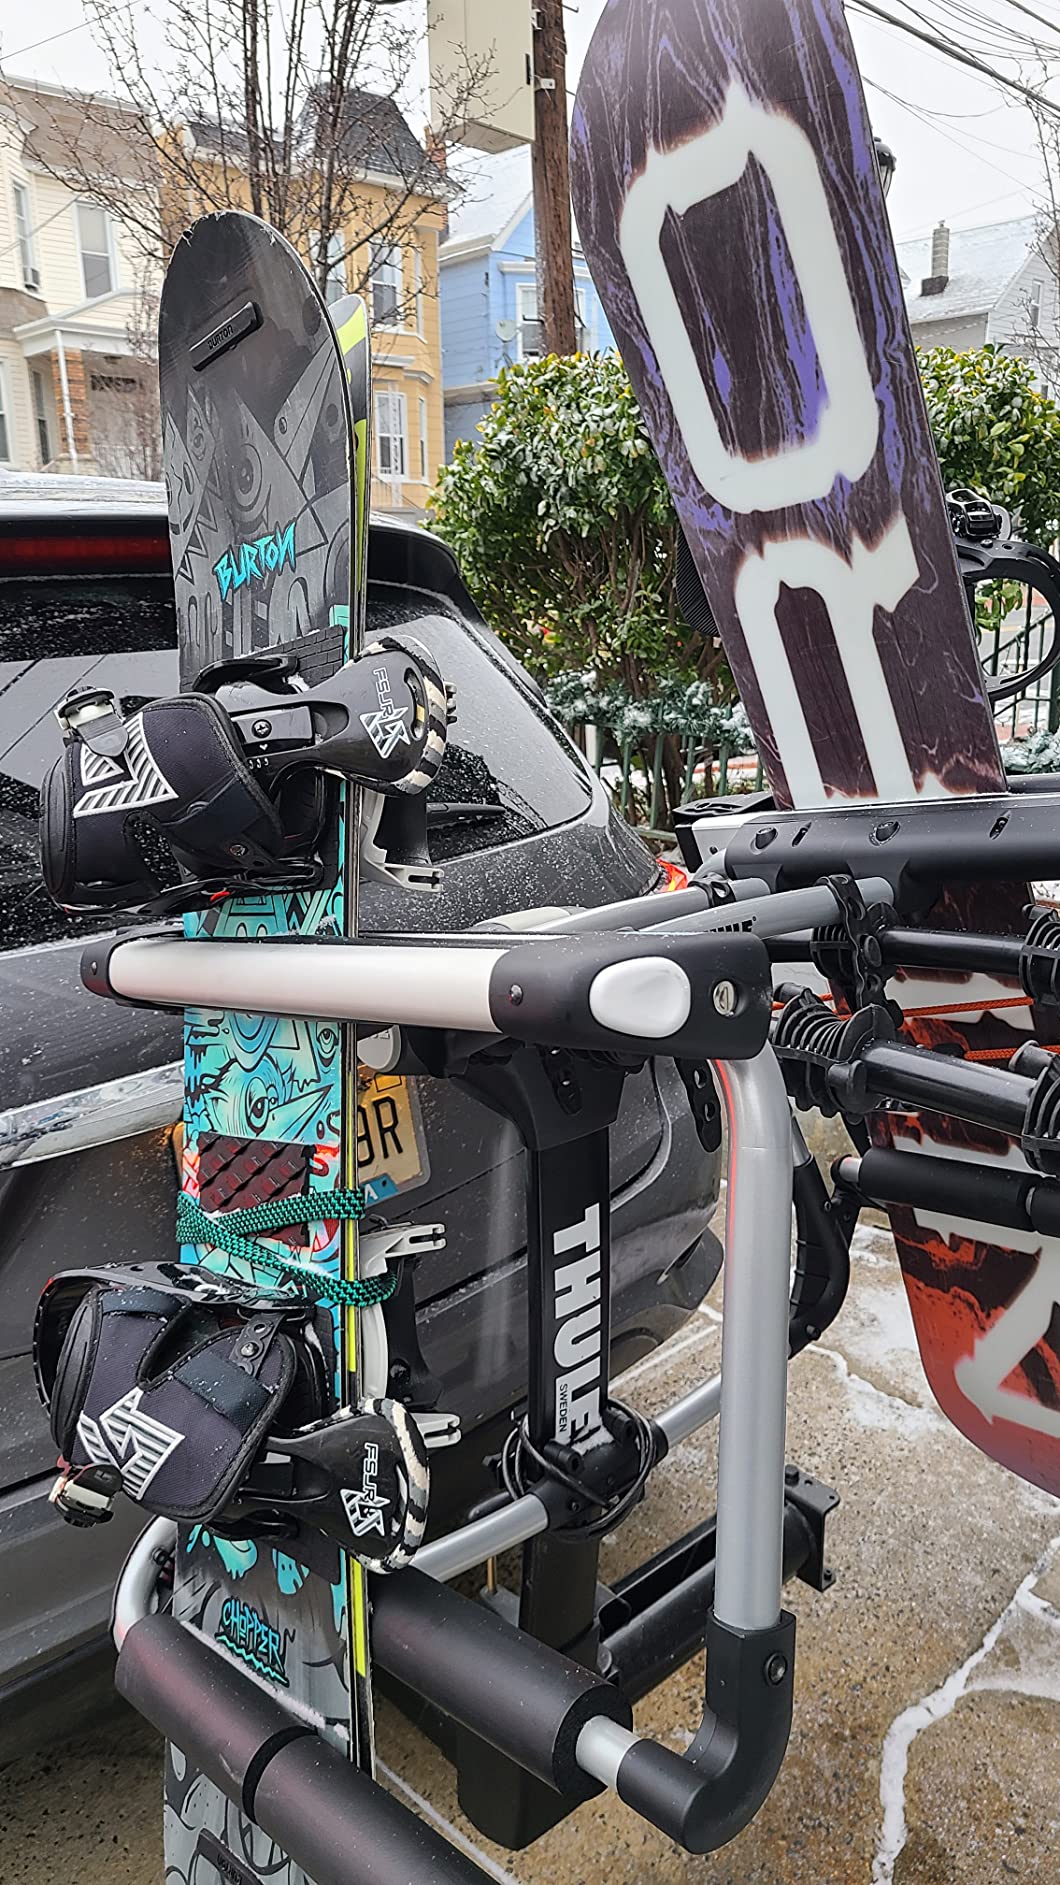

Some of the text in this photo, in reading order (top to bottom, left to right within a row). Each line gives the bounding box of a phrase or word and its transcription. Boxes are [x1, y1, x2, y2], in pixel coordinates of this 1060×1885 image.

[207, 324, 234, 350] BURTON
[212, 520, 297, 602] BURTON
[553, 1202, 601, 1446] THULE
[558, 1383, 570, 1433] SWEDEN
[221, 1597, 285, 1674] CHOPPER
